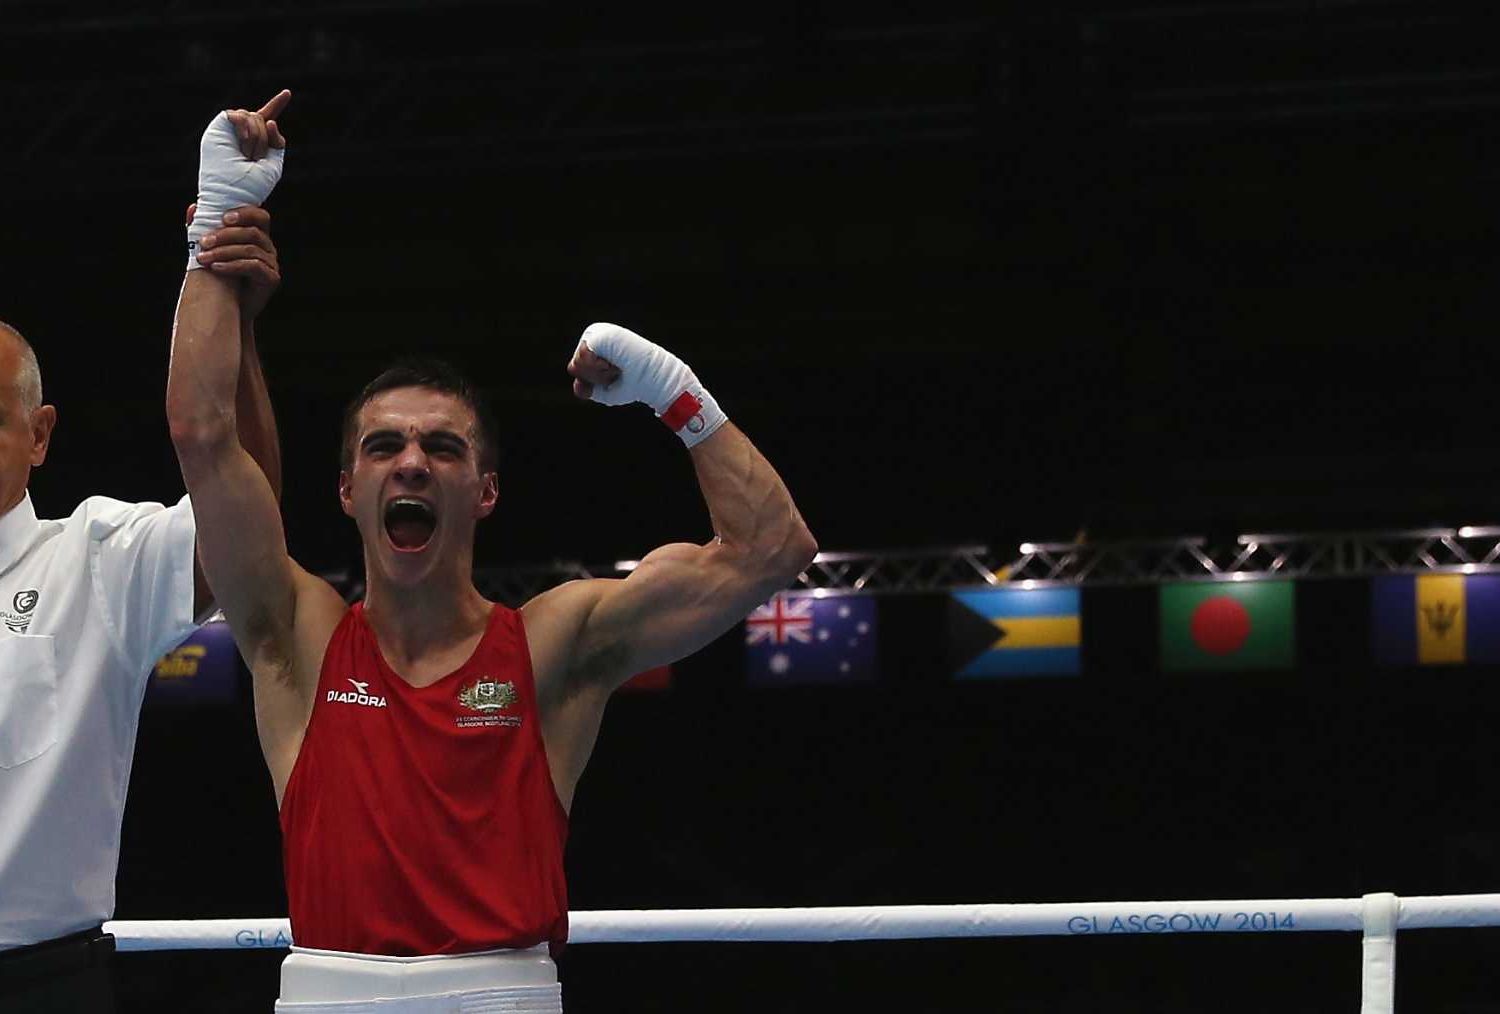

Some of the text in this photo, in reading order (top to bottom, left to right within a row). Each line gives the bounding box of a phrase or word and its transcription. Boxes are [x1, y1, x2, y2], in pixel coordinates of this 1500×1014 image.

[326, 690, 387, 707] DIADORA
[1067, 911, 1296, 934] GLASGOW 2014
